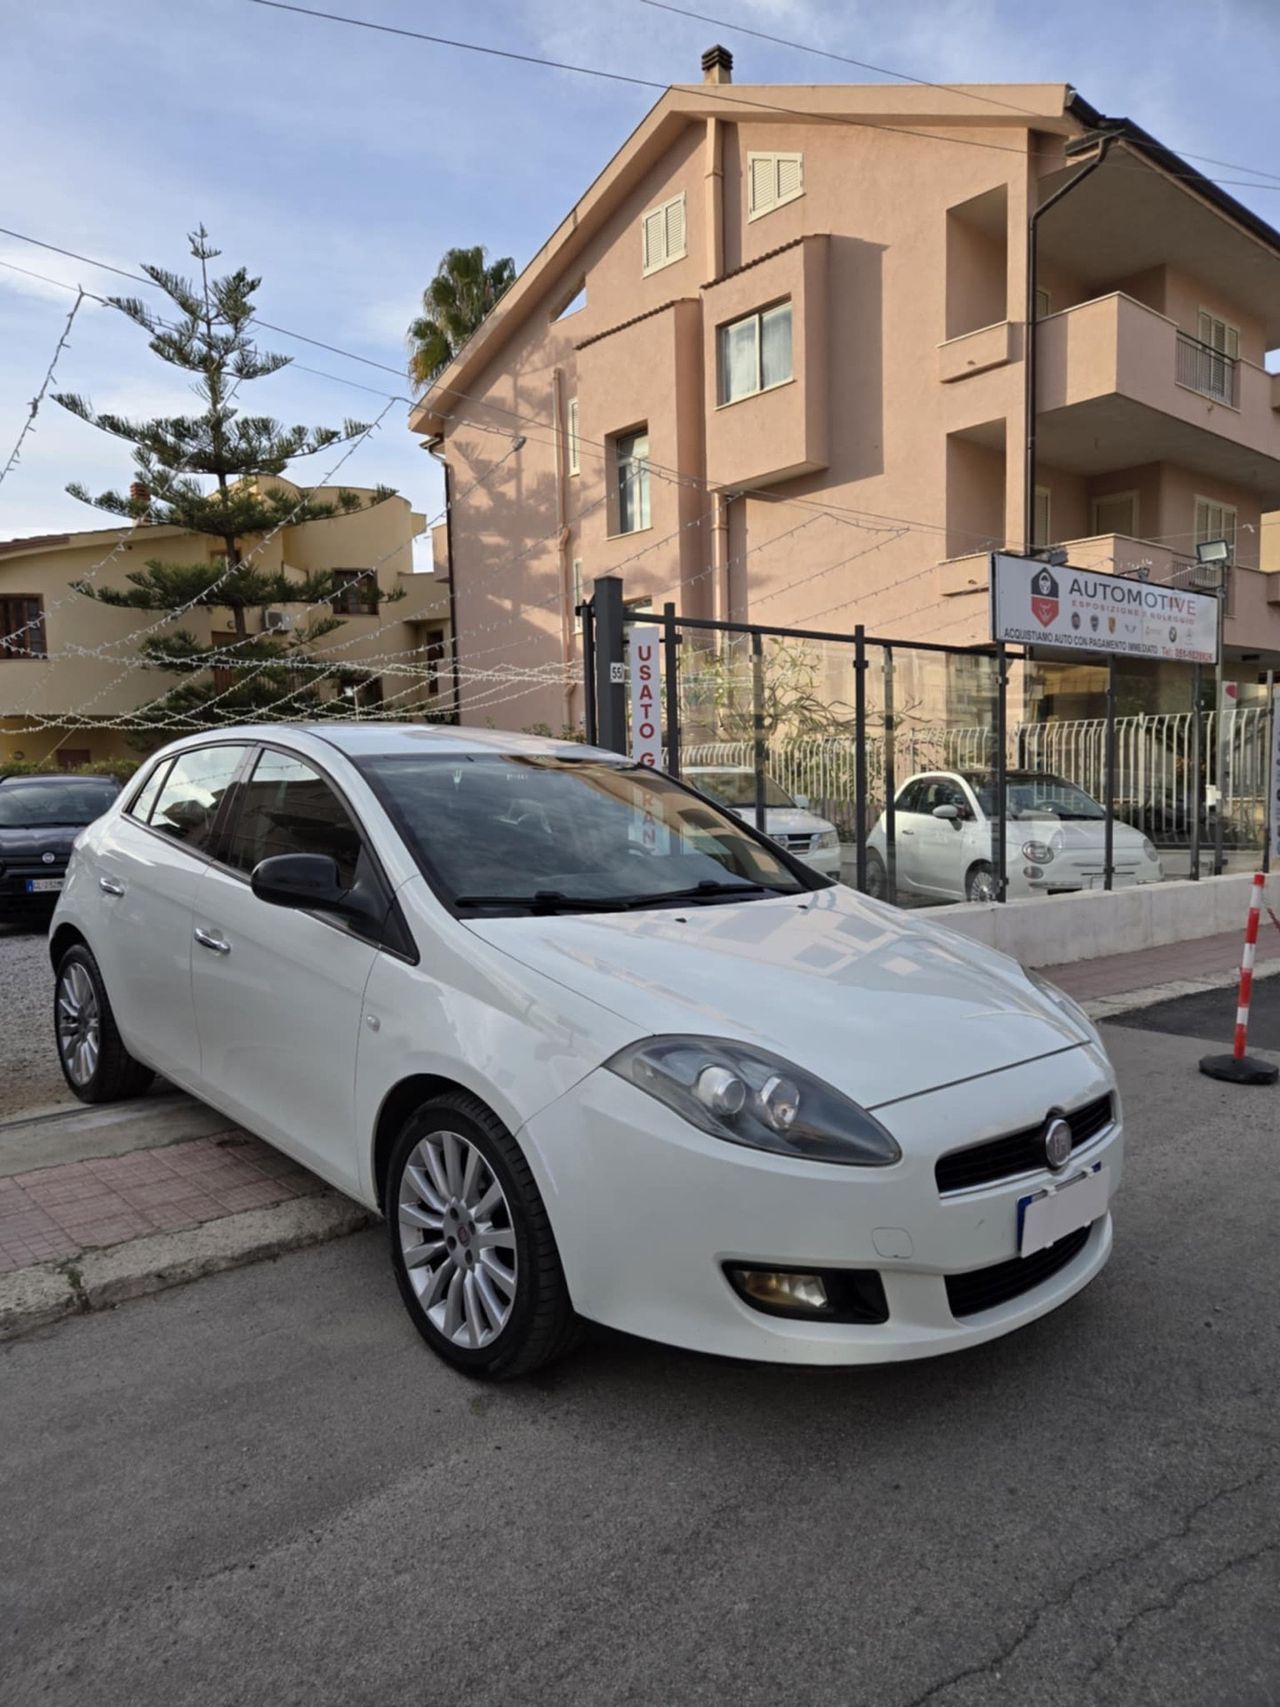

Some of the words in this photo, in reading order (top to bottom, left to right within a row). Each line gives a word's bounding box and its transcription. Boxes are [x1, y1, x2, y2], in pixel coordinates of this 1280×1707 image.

[1069, 578, 1197, 616] AUTOMOTIVE
[1071, 600, 1140, 617] ESPOSIZIONE
[1004, 628, 1053, 642] ACQUISTIAMO
[1054, 634, 1072, 644] AUTO
[1074, 635, 1087, 646] CON
[1089, 637, 1127, 651] PAGAMENTO
[612, 666, 622, 680] 55
[638, 645, 655, 739] USATO
